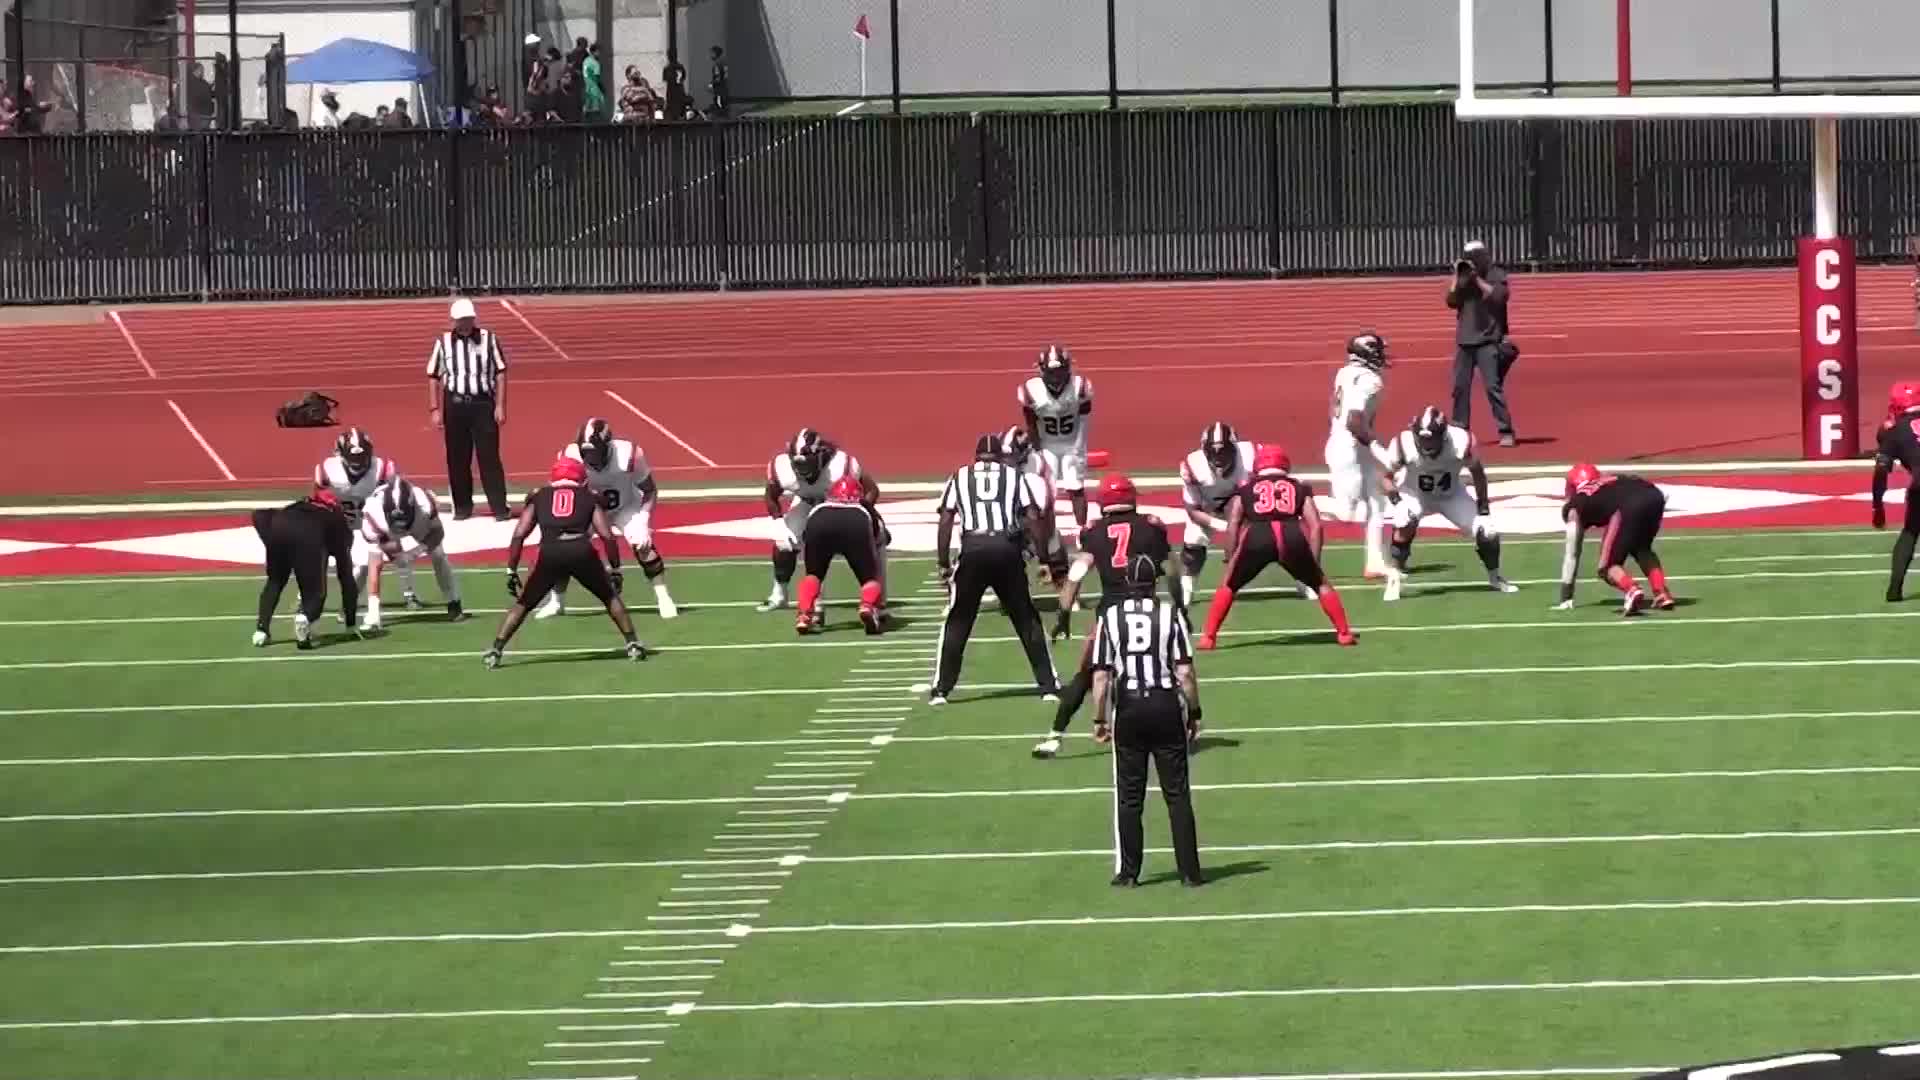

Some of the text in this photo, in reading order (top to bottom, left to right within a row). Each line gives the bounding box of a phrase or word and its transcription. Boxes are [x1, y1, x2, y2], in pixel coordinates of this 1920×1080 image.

[1815, 249, 1843, 455] CCSF
[1043, 416, 1074, 435] 25
[973, 470, 1001, 500] U
[1253, 480, 1297, 514] 33
[552, 489, 575, 518] 0
[1106, 523, 1131, 568] 7
[1125, 614, 1152, 652] B
